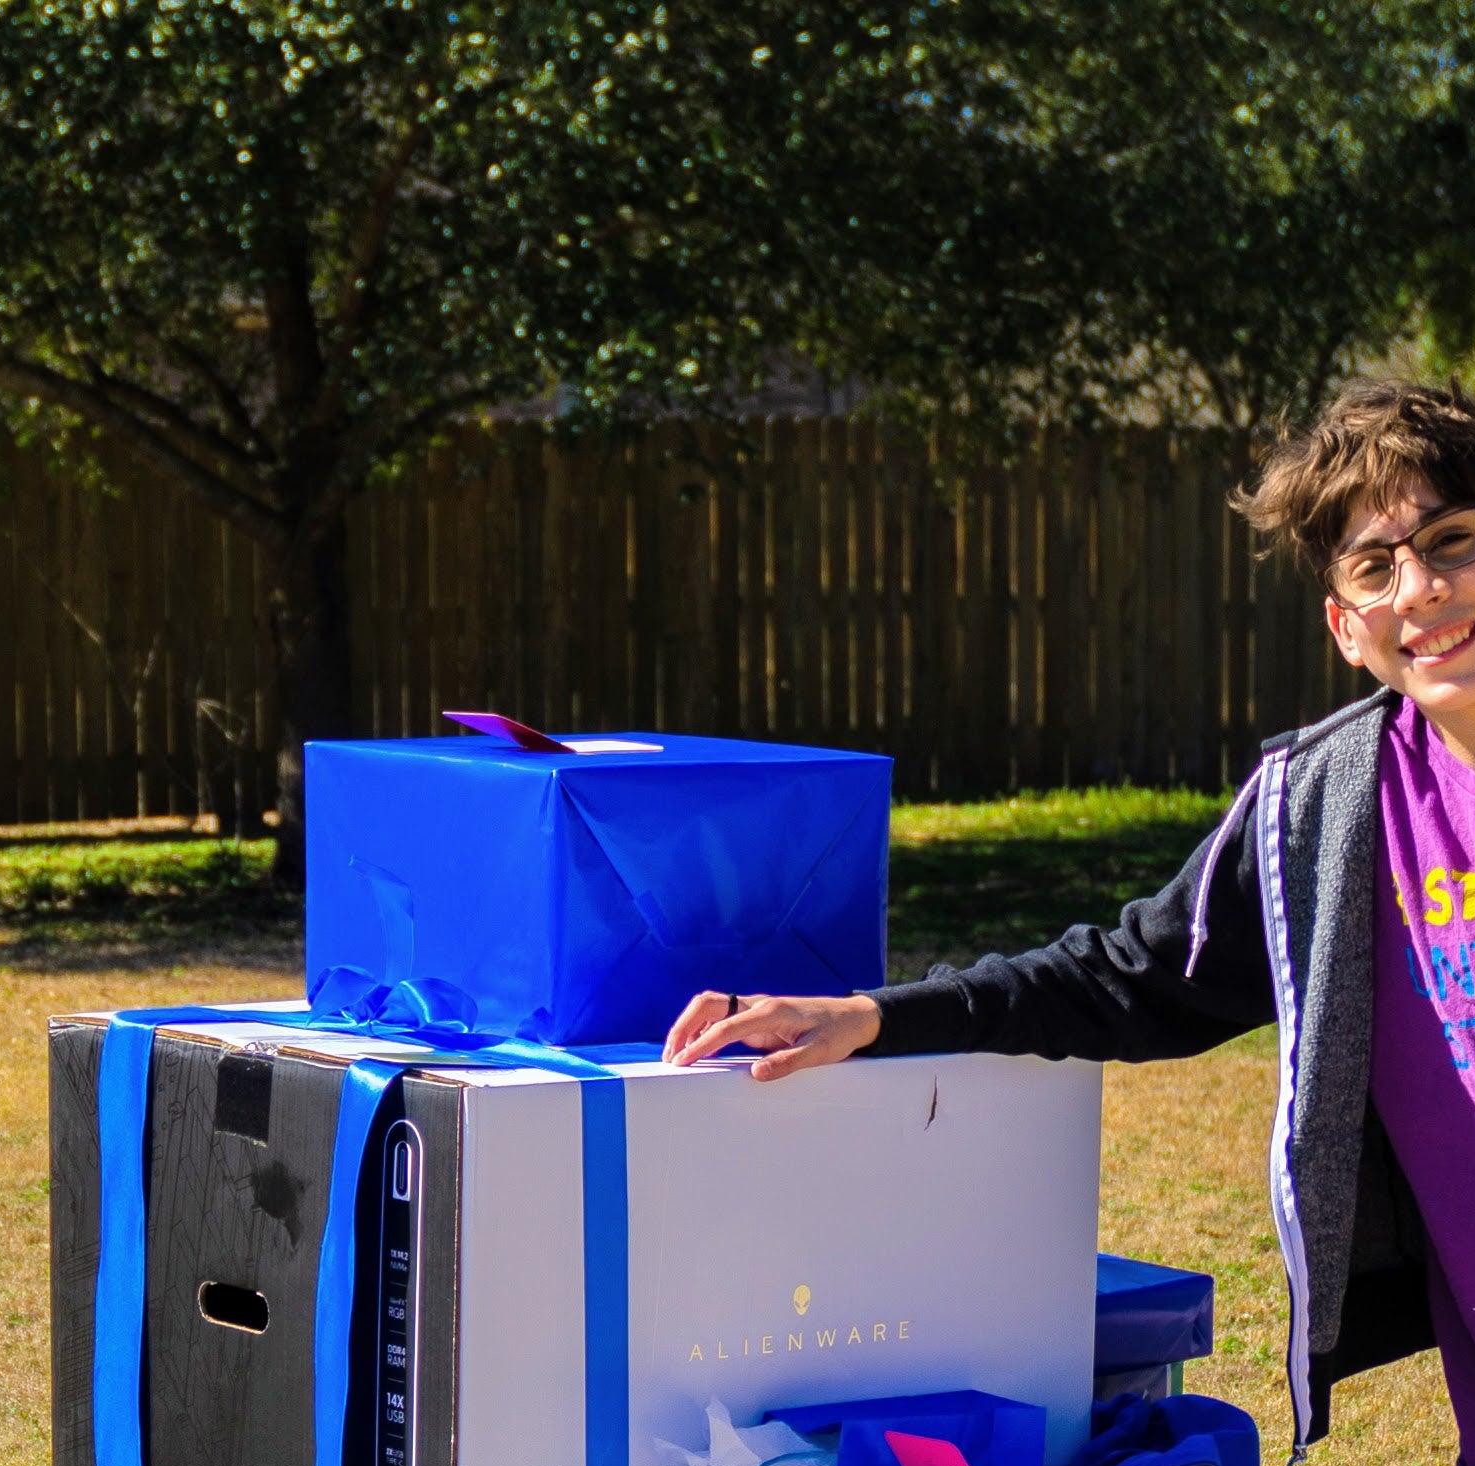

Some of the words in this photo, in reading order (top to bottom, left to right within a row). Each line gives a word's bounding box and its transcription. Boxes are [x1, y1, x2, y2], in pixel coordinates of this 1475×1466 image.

[388, 1306, 405, 1320] RGB
[688, 1320, 912, 1363] ALIENWARE
[387, 1354, 406, 1369] RAM
[386, 1391, 405, 1409] 14X
[386, 1407, 405, 1424] USB
